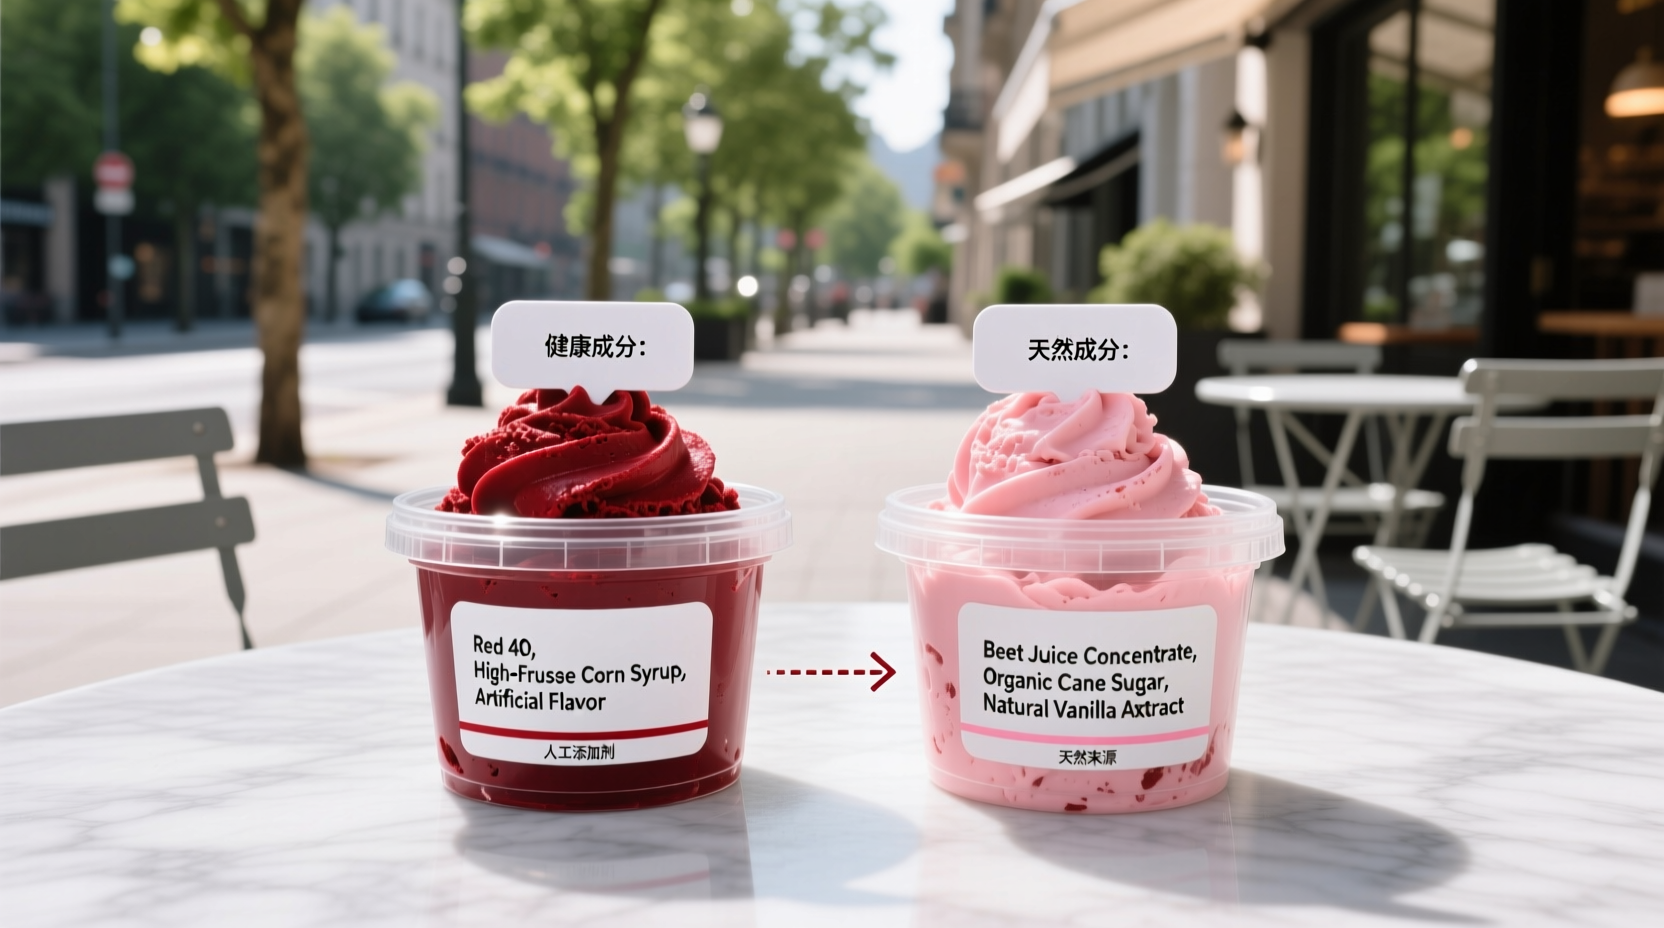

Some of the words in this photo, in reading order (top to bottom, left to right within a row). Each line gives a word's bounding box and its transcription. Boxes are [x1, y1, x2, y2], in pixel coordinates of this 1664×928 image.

[473, 634, 503, 655] Red
[508, 638, 536, 660] 40,
[983, 639, 1023, 661] Beet
[1028, 645, 1078, 664] Juice
[1083, 644, 1197, 665] Concentrate,
[474, 660, 576, 685] High-Frusse
[581, 665, 625, 684] Corn
[630, 664, 687, 687] Syrup,
[983, 667, 1052, 692] Organic
[1057, 673, 1106, 691] Cane
[1111, 673, 1168, 696] Sugar,
[475, 688, 543, 710] Artificial
[549, 692, 606, 711] Flavor
[983, 693, 1048, 717] Natural
[1053, 699, 1116, 719] Vanilla
[1121, 697, 1184, 718] Axtract
